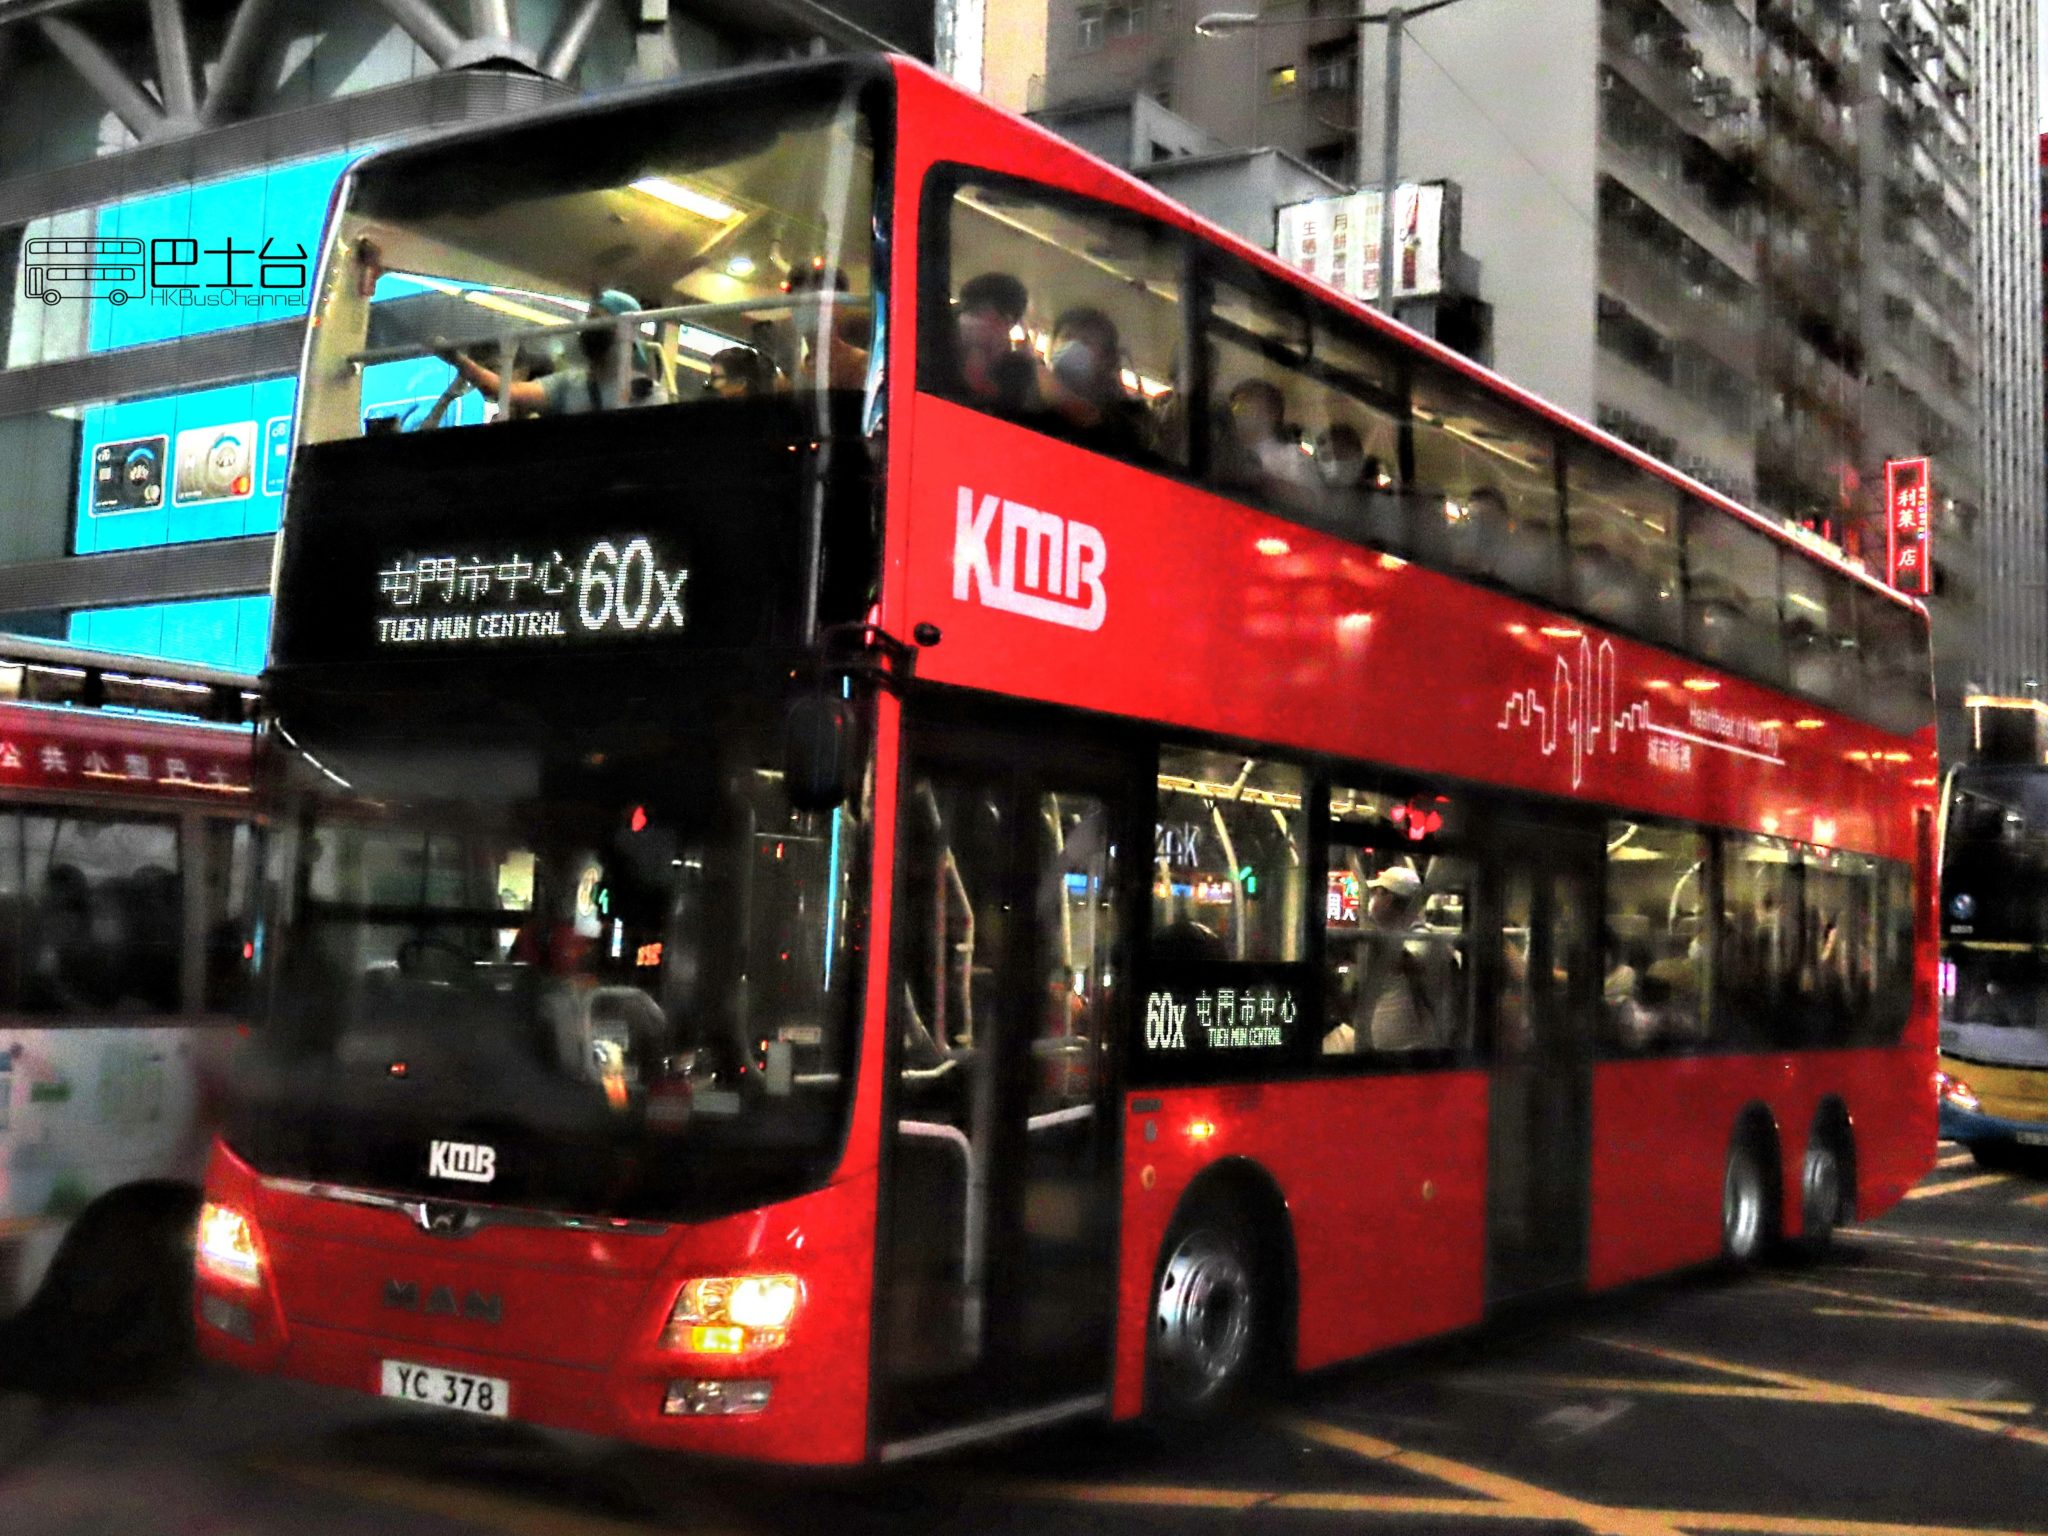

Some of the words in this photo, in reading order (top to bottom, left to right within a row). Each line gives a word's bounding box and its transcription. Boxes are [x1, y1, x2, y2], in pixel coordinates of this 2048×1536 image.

[378, 552, 573, 605] 屯門市中心
[952, 485, 1107, 632] KMB
[379, 618, 427, 642] TUEN
[431, 616, 470, 640] MUN
[476, 611, 566, 638] CENTRAL
[1195, 989, 1296, 1026] 屯門市中心
[1208, 1028, 1229, 1047] TUEN
[1230, 1028, 1248, 1046] MUN
[1250, 1027, 1282, 1046] CENTRAL
[429, 1140, 496, 1183] KMB
[397, 1366, 429, 1399] YC
[442, 1375, 494, 1412] 378
